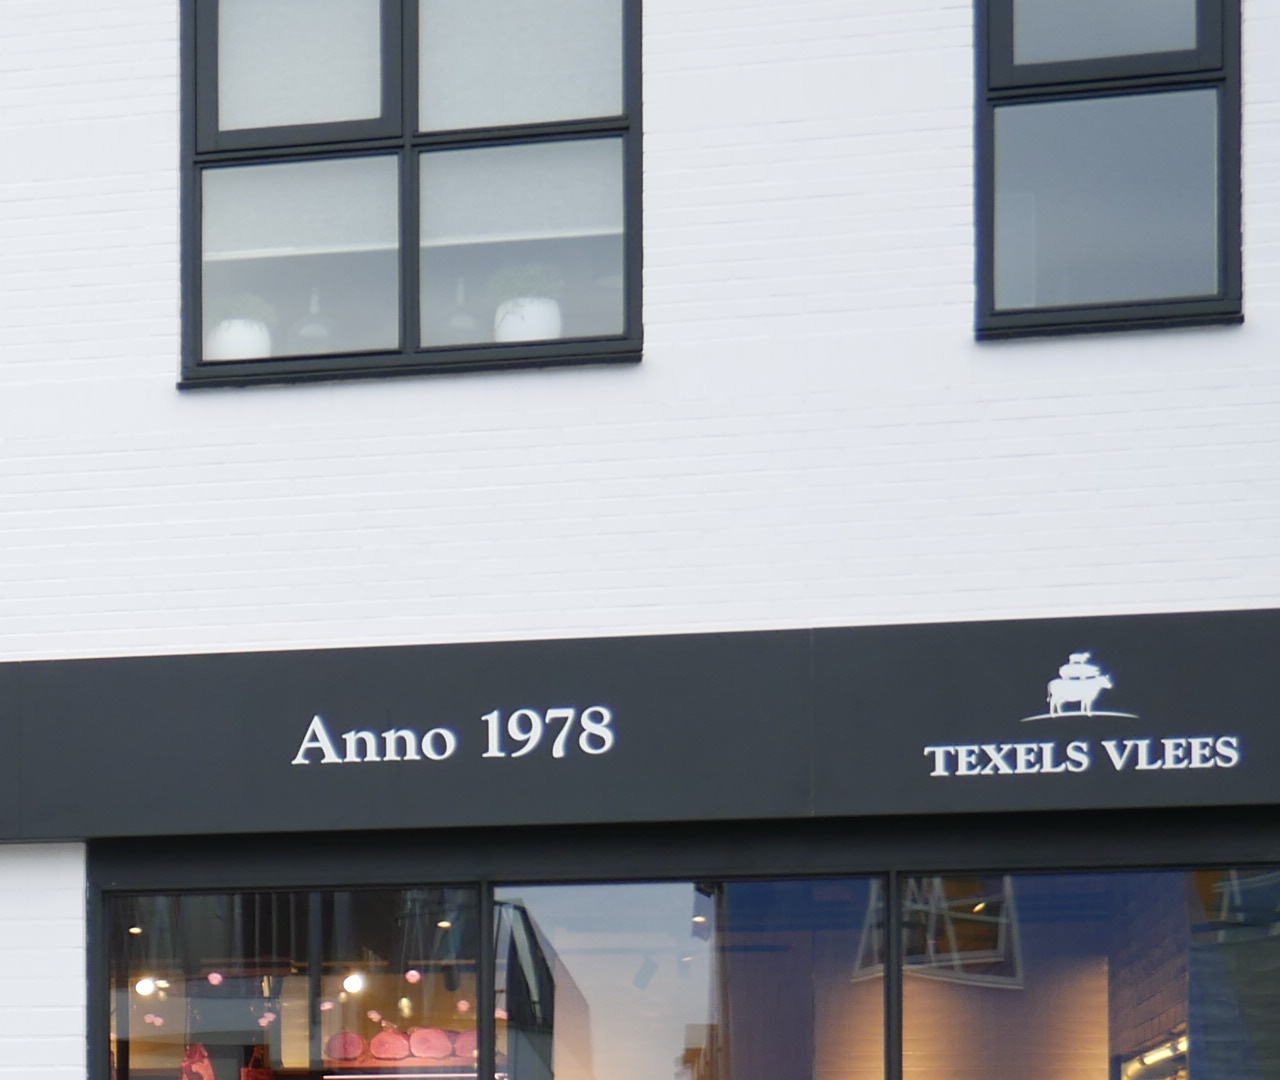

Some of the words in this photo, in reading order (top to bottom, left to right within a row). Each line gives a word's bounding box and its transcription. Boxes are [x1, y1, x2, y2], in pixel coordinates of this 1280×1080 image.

[290, 714, 457, 765] Anno
[480, 705, 615, 759] 1978
[923, 740, 1091, 777] TEXELS
[1100, 736, 1240, 771] VLEES
